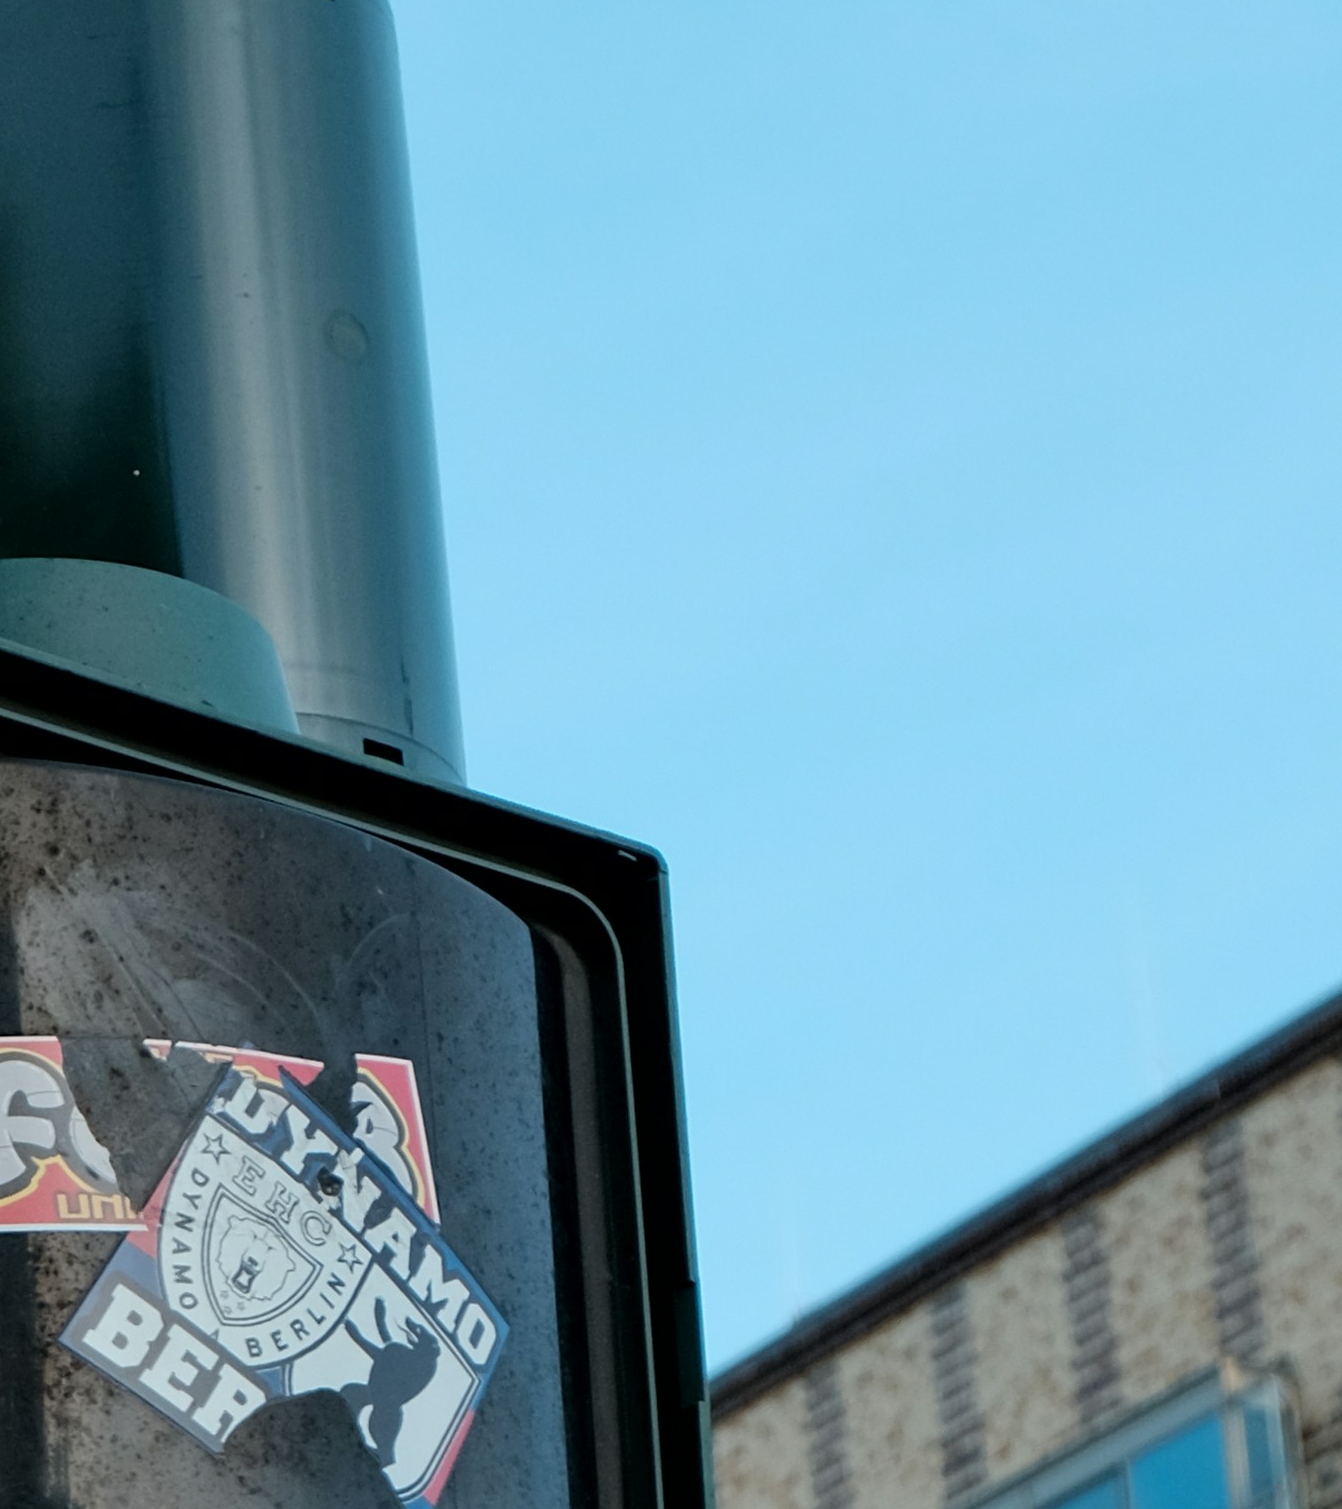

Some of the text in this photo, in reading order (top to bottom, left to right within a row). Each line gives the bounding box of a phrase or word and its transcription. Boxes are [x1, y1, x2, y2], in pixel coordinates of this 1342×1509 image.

[172, 1167, 210, 1312] DYNAMO
[217, 1081, 496, 1366] DYNAMO
[232, 1155, 332, 1248] EHC
[81, 1283, 268, 1442] BER
[244, 1271, 362, 1359] BERLIN
